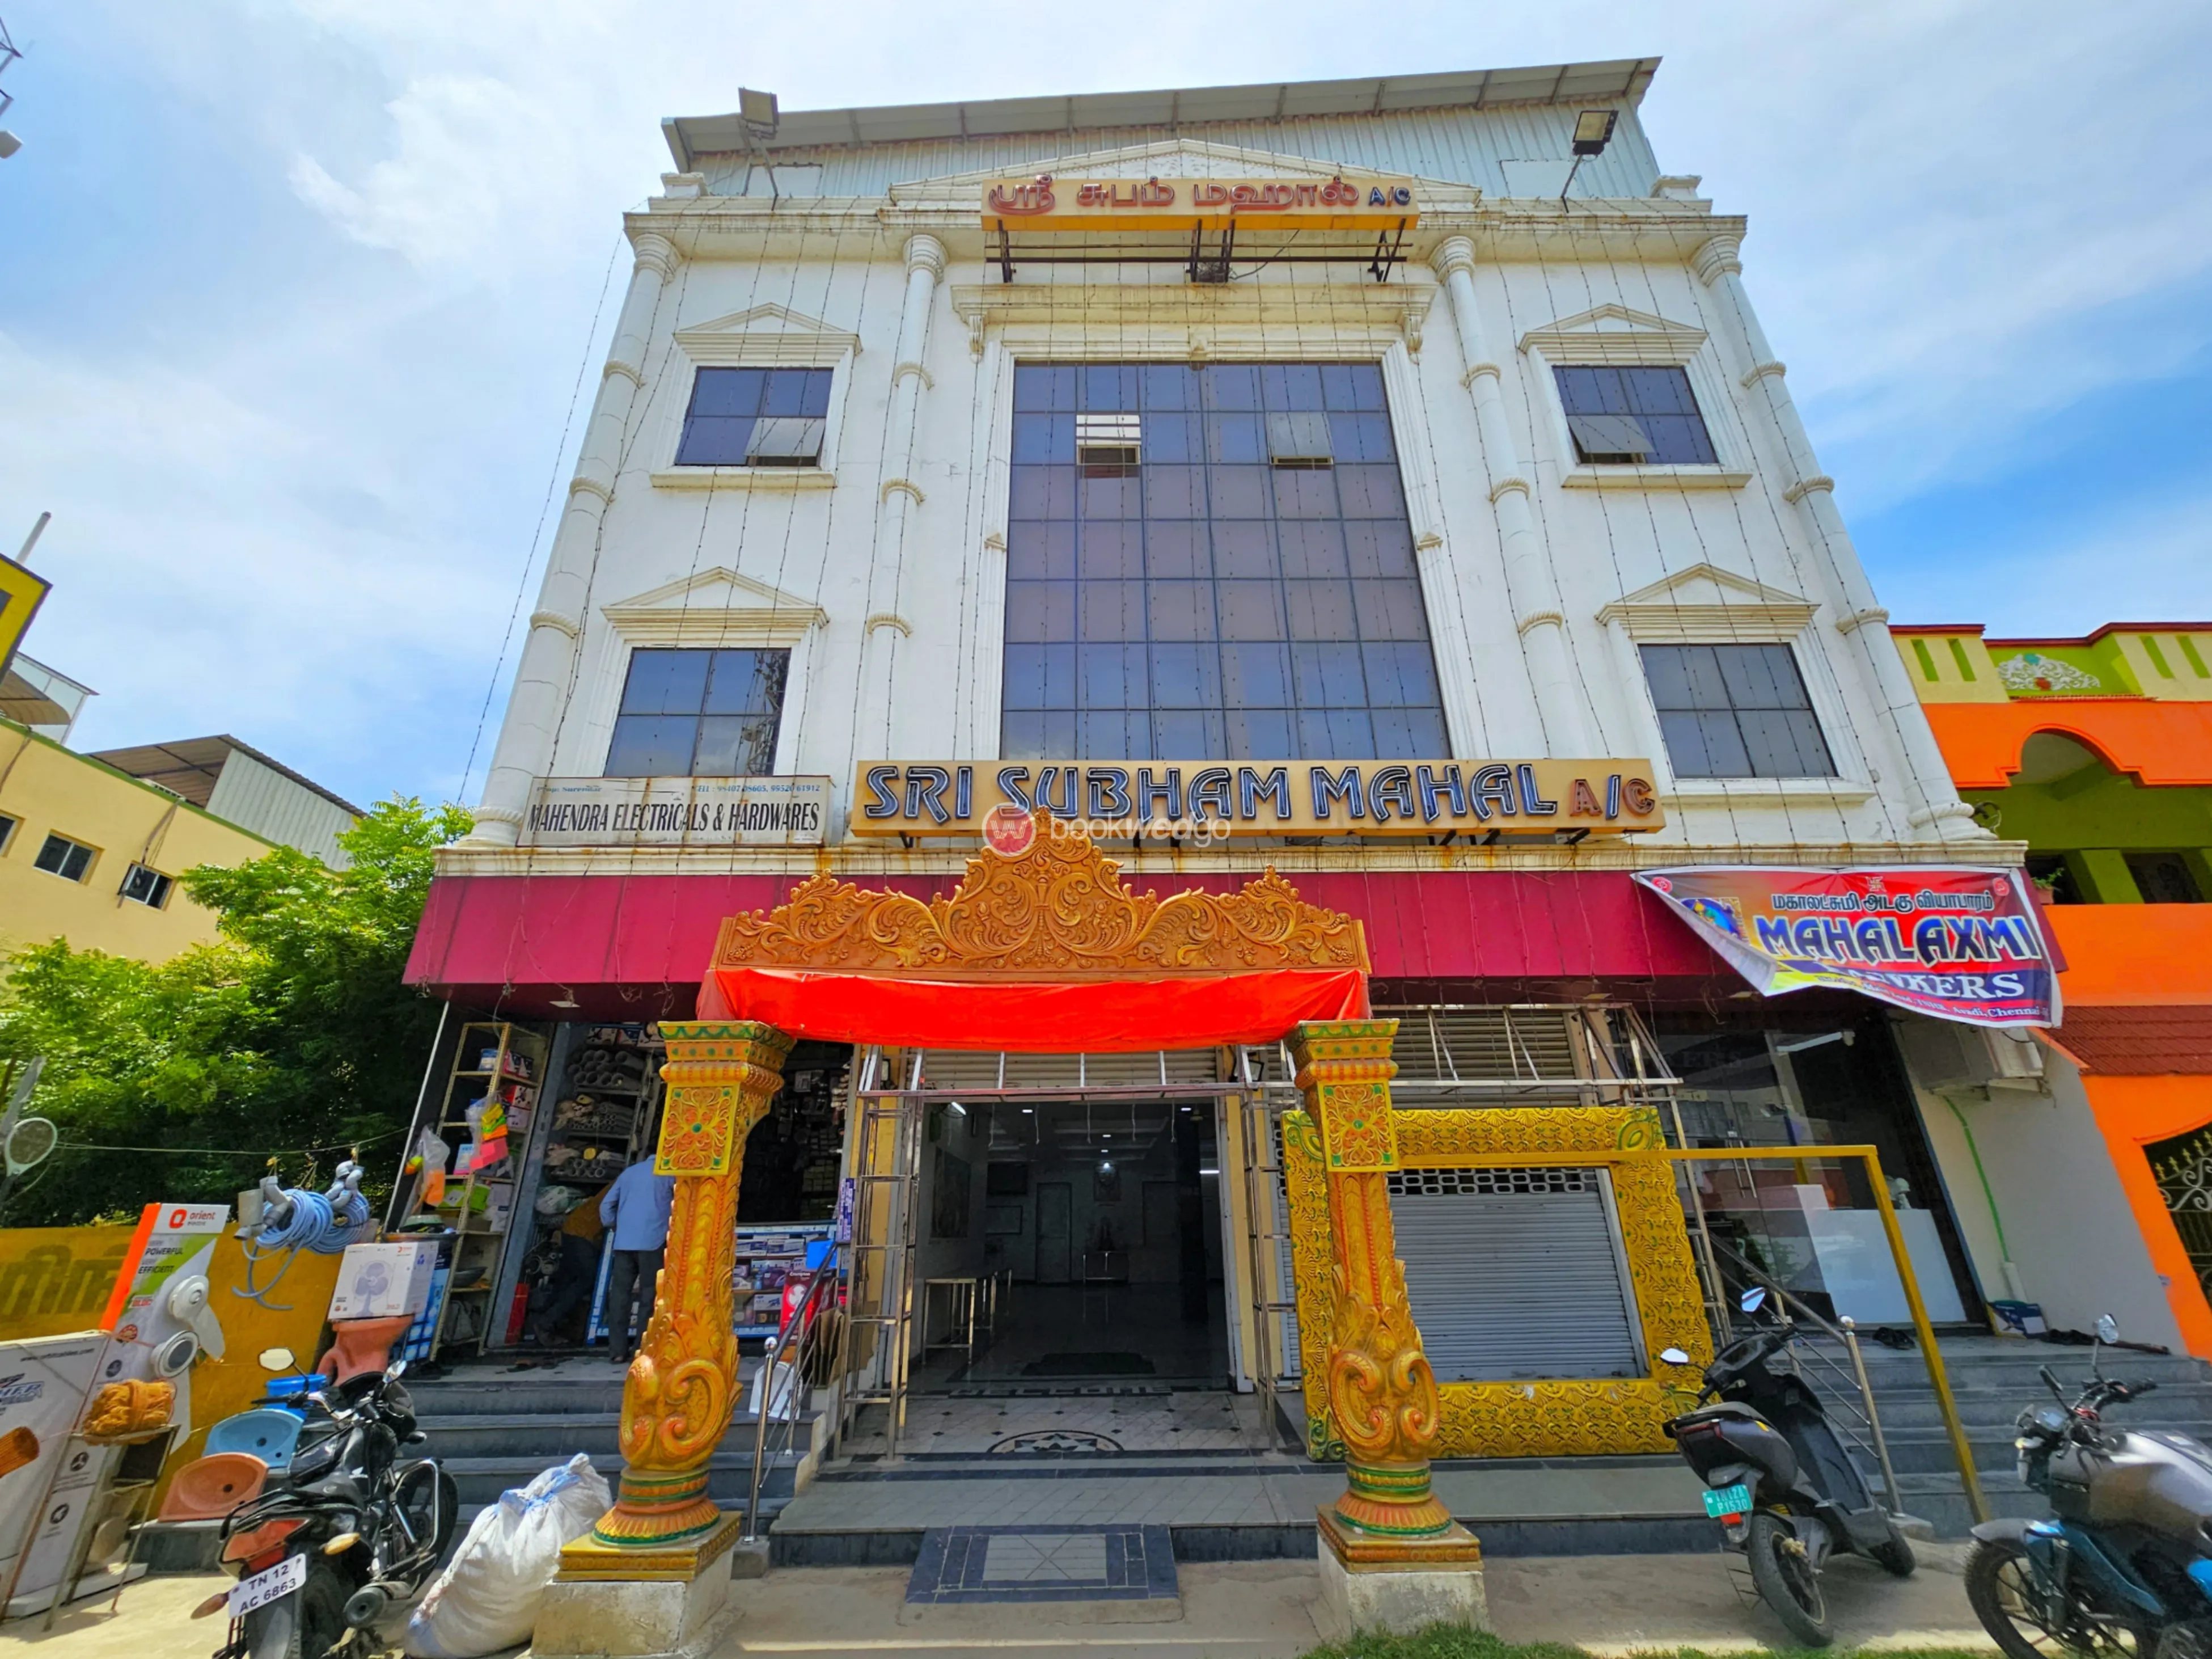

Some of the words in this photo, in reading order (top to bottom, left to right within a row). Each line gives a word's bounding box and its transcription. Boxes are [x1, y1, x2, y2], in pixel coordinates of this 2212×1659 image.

[1076, 175, 1175, 206] சுபம்
[1194, 175, 1359, 214] மஹால்
[1368, 186, 1411, 207] A/C
[865, 766, 973, 825] SRI
[997, 766, 1292, 824] SUBHAM
[1309, 763, 1558, 824] MAHAL
[1569, 774, 1655, 820] A/C
[526, 803, 608, 831] MAHENDRA
[612, 803, 710, 831] ELECTRICALS
[713, 803, 725, 831] &
[728, 802, 819, 831] HARDWARES
[1772, 892, 1860, 910] மகாலட்சுமி
[1864, 893, 1914, 911] அடகு
[1916, 890, 1994, 911] வியாபாரம்
[1754, 915, 2041, 967] MAHALAXMI
[189, 1210, 216, 1220] orient
[138, 1265, 175, 1274] EFFICIENT
[248, 1574, 268, 1590] TN
[273, 1564, 289, 1578] 12
[239, 1595, 259, 1613] AC
[264, 1577, 297, 1601] 6863
